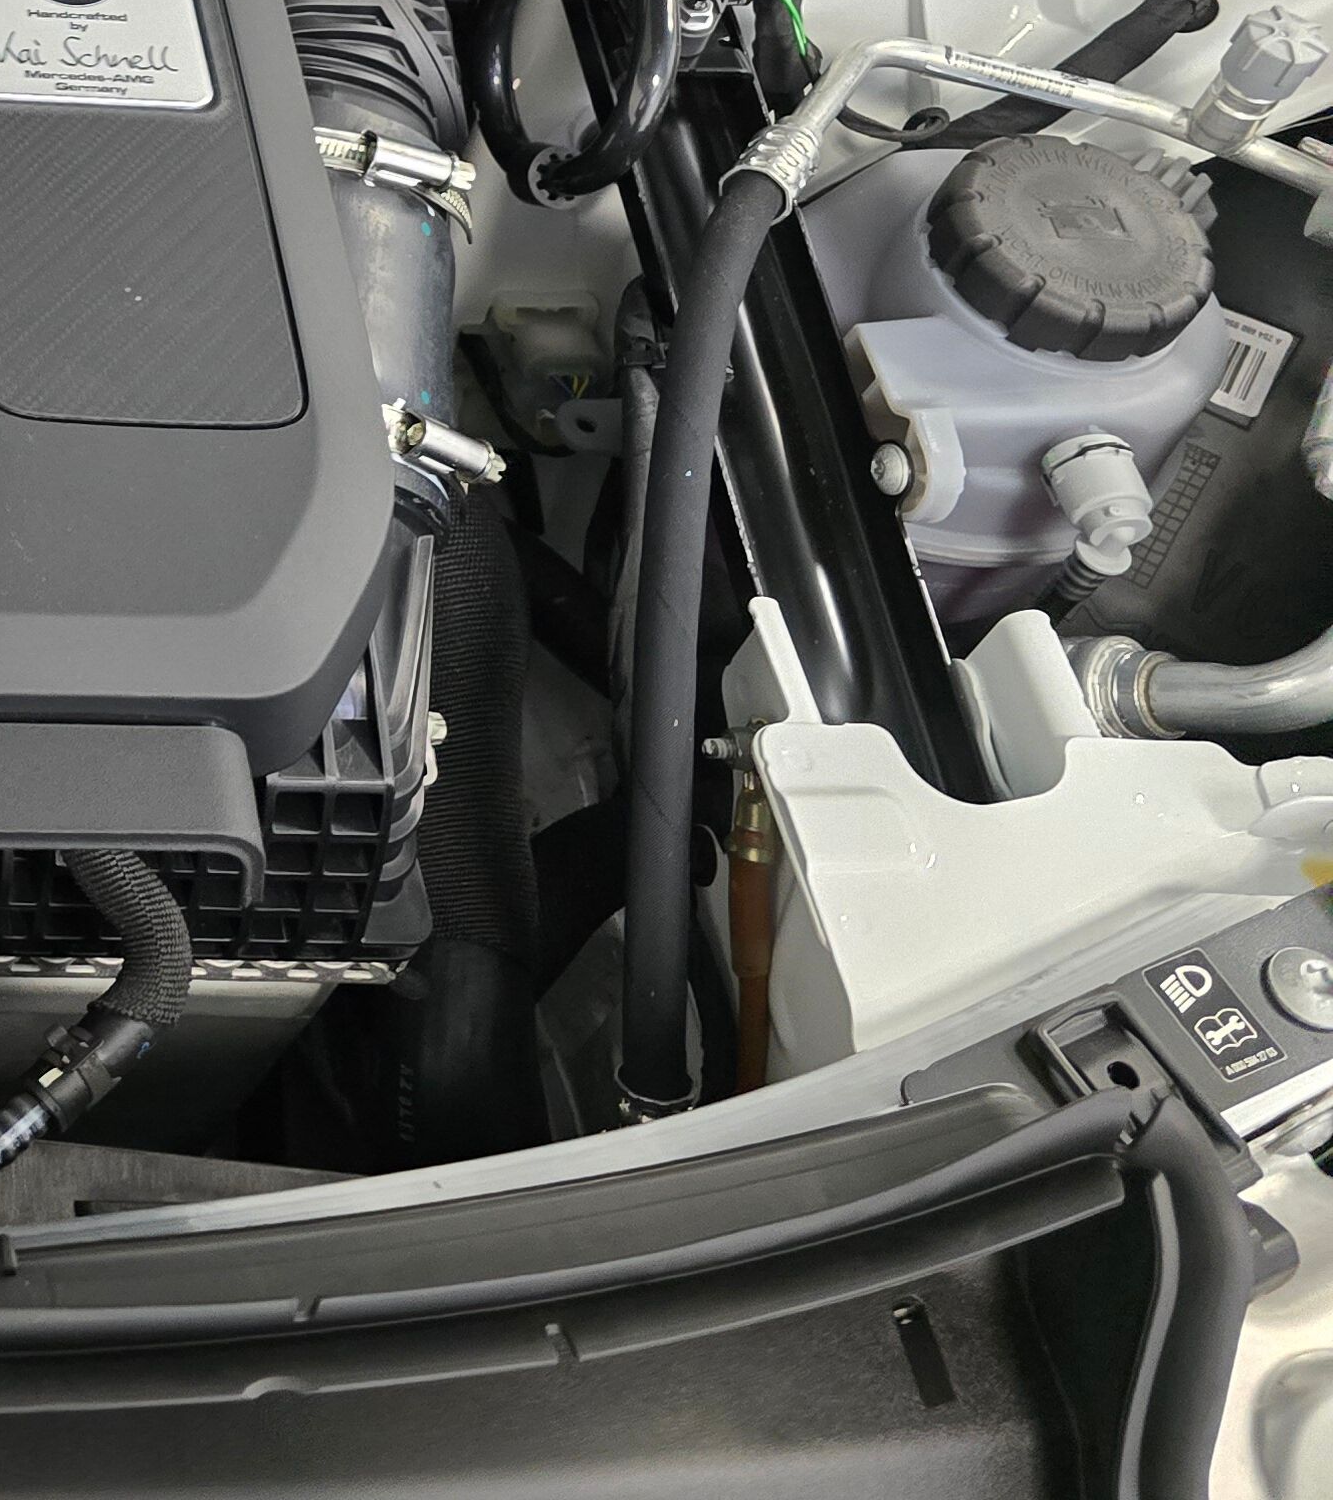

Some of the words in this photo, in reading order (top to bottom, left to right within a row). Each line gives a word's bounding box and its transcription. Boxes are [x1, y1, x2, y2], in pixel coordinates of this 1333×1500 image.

[26, 8, 128, 22] Handcrafted
[69, 21, 89, 33] by
[24, 69, 155, 85] Mercedes-AMG
[55, 81, 129, 96] Germany
